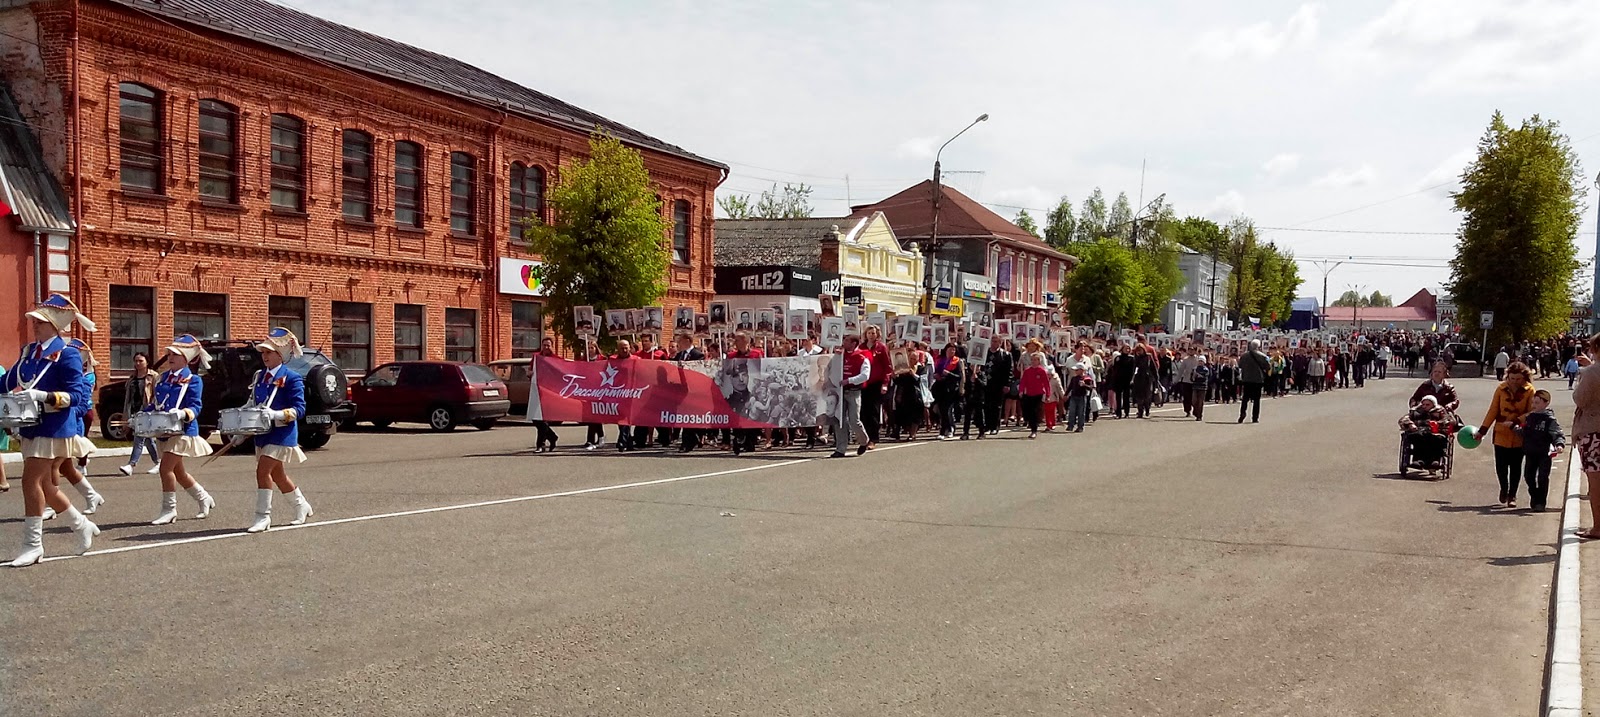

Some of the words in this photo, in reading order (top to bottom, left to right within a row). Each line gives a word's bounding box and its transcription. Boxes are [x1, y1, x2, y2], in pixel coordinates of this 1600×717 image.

[740, 270, 784, 290] TELE2
[820, 278, 840, 297] TELE2
[947, 304, 961, 315] СЕТЬ
[559, 373, 650, 400] Бессмертный
[591, 402, 620, 416] ПОЛК
[660, 410, 729, 424] Новозыбков
